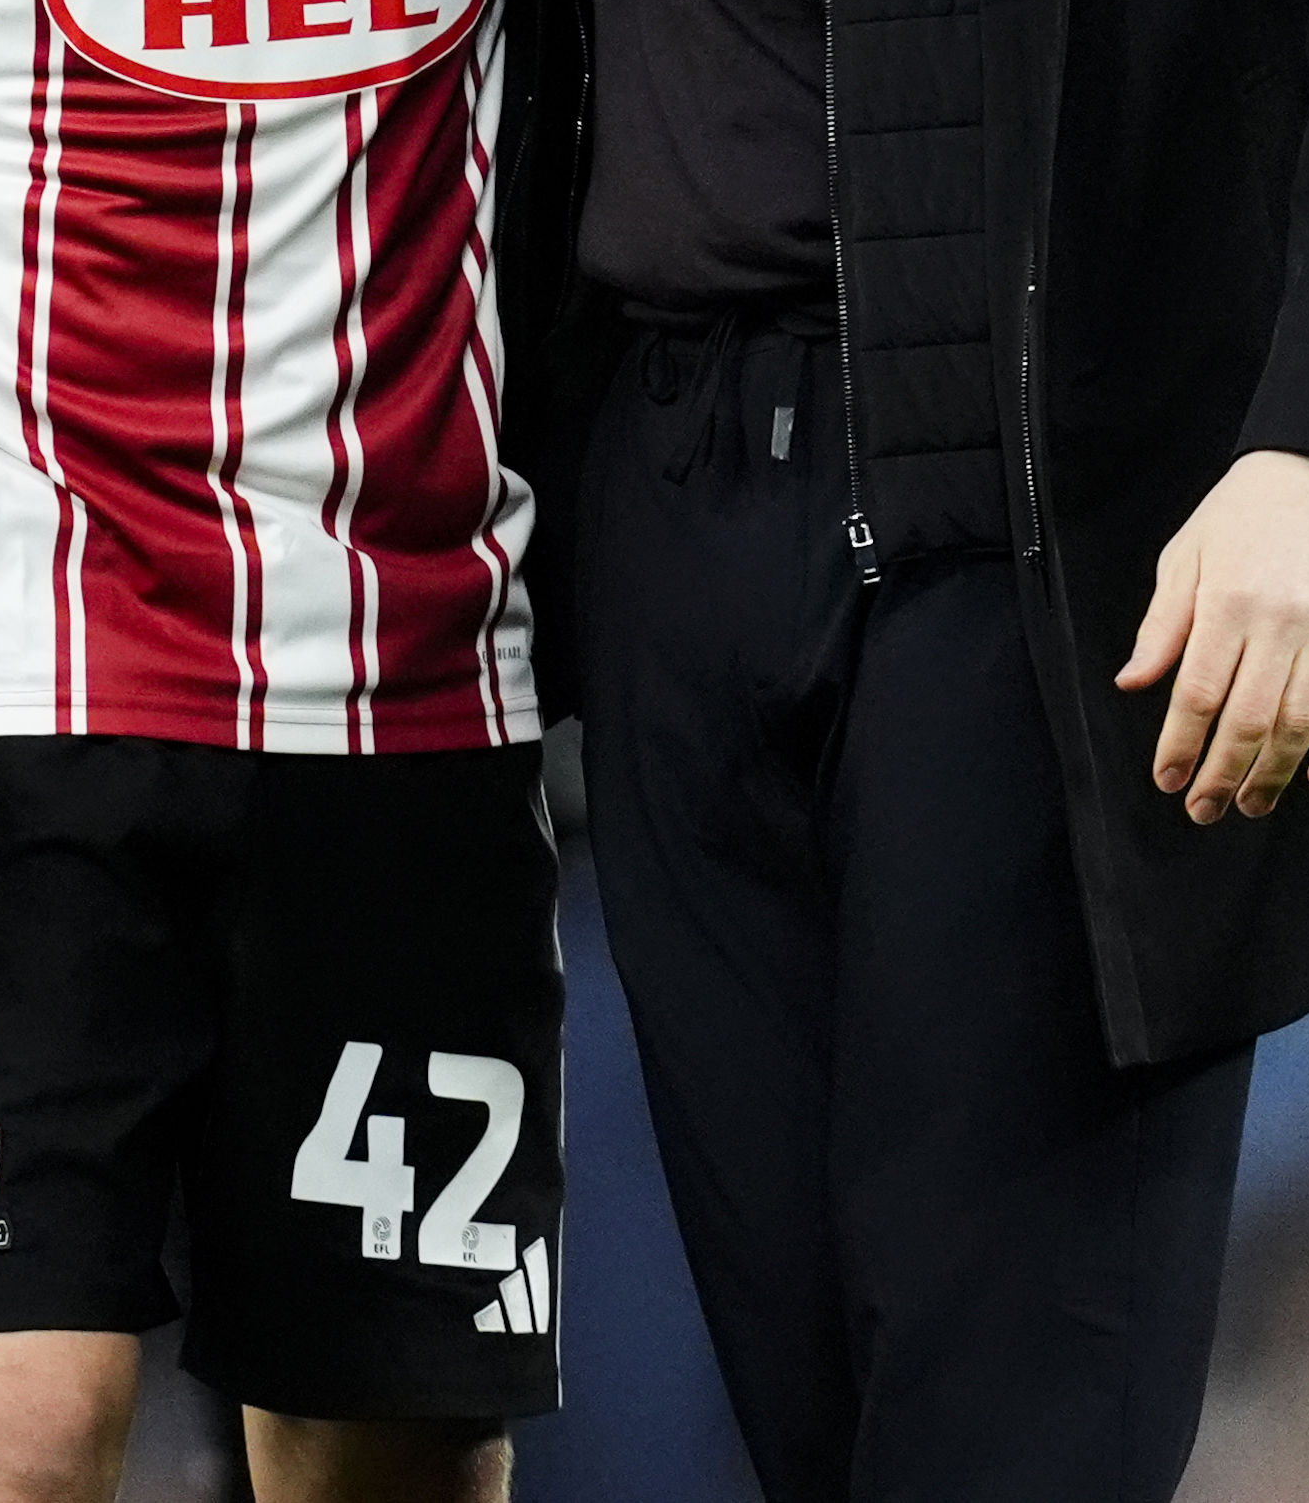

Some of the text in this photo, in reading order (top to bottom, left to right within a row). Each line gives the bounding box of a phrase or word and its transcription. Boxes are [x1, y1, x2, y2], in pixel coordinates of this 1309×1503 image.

[291, 1041, 525, 1271] 42
[374, 1243, 390, 1255] EFL
[463, 1251, 478, 1264] EFL
